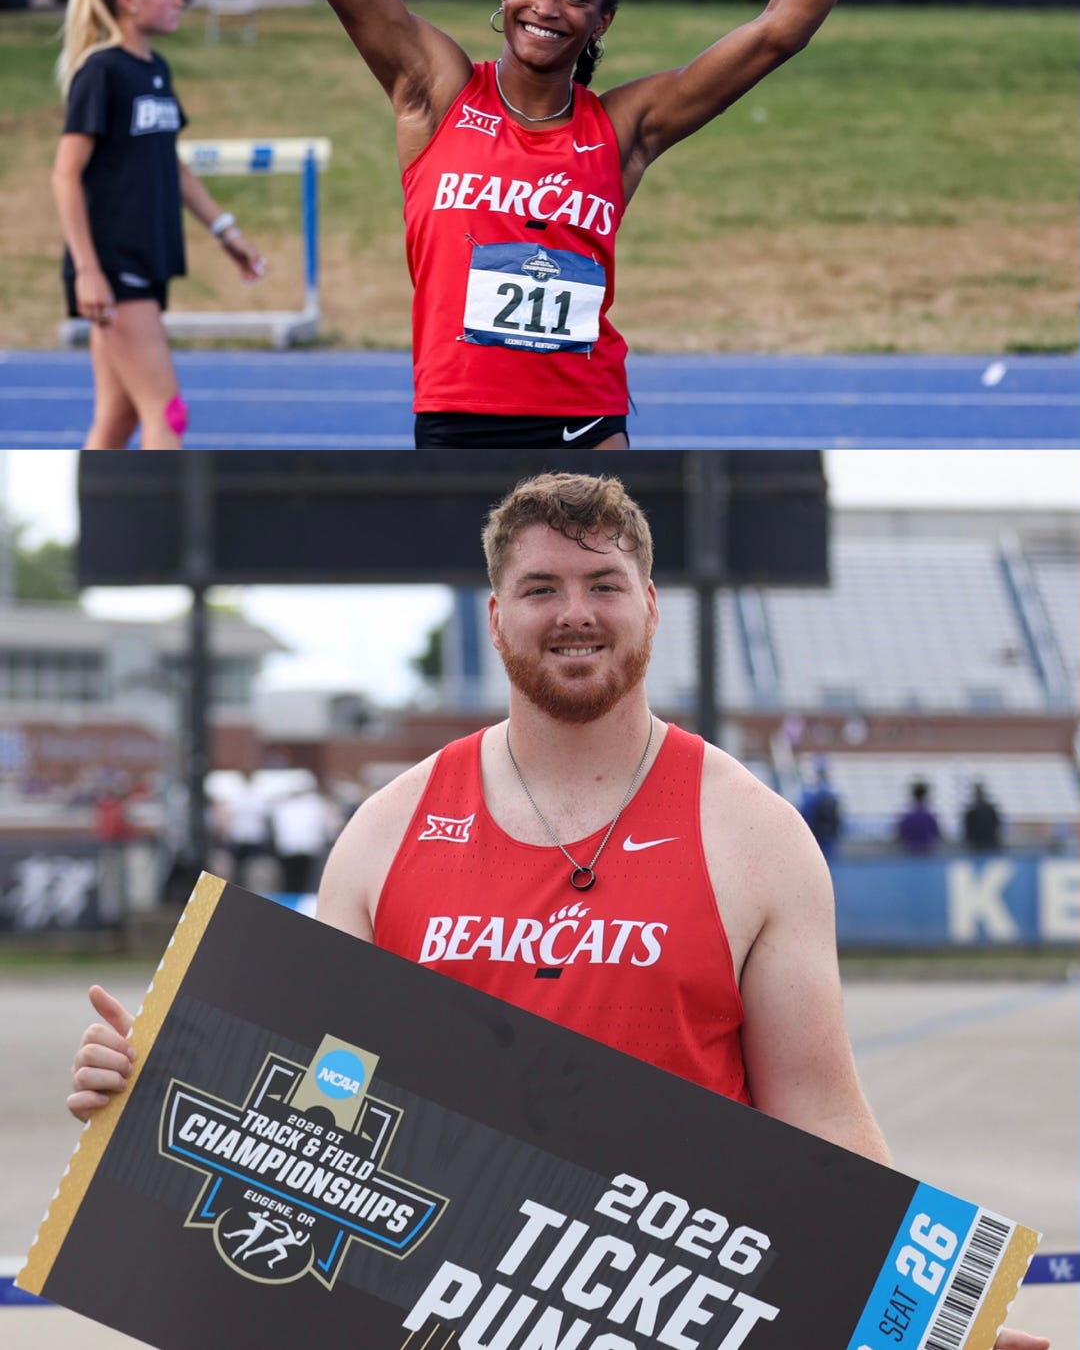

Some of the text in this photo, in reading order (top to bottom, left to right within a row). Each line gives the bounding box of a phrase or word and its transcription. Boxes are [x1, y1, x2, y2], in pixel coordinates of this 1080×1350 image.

[433, 172, 615, 236] BEARCATS
[493, 282, 571, 336] 211
[417, 904, 668, 967] BEARCATS
[317, 1067, 361, 1095] NCAA
[241, 1109, 376, 1181] TRACK & FIELD
[287, 1114, 322, 1136] 2026
[178, 1113, 415, 1234] CHAMPIONSHIPS
[243, 1189, 316, 1228] EUGENE, OR
[594, 1172, 771, 1276] 2026
[496, 1198, 781, 1350] TICKET
[878, 1212, 958, 1343] SEAT 26
